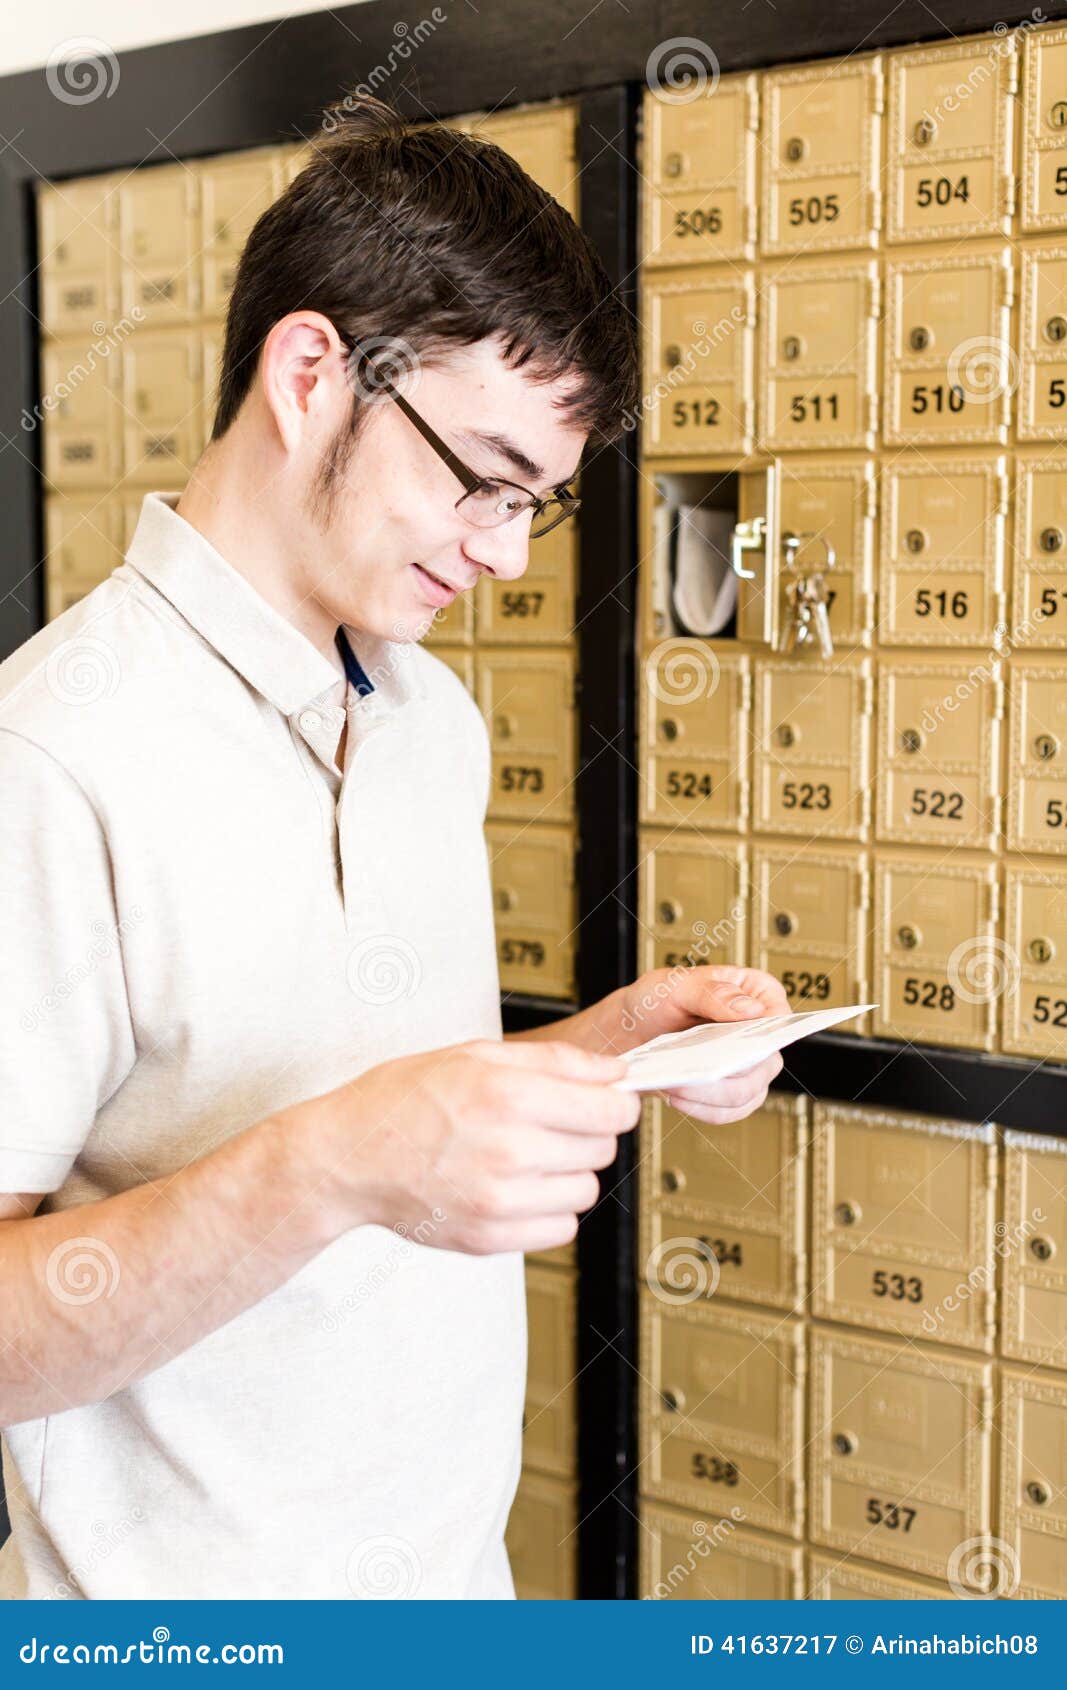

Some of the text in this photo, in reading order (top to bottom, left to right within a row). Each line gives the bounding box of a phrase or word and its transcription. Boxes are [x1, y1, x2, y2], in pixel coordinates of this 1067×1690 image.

[917, 176, 970, 208] 504
[674, 207, 722, 238] 506
[789, 194, 840, 227] 505
[673, 399, 720, 428] 512
[790, 394, 839, 424] 511
[911, 385, 966, 415] 510
[501, 592, 544, 618] 567
[914, 589, 969, 620] 516
[500, 767, 544, 793] 573
[667, 772, 713, 799] 524
[782, 782, 832, 811] 523
[910, 789, 965, 821] 522
[501, 940, 546, 967] 579
[782, 972, 831, 1000] 529
[903, 978, 956, 1012] 528
[1032, 996, 1067, 1028] 52
[872, 1270, 924, 1305] 533
[691, 1452, 739, 1487] 538
[866, 1498, 918, 1533] 537
